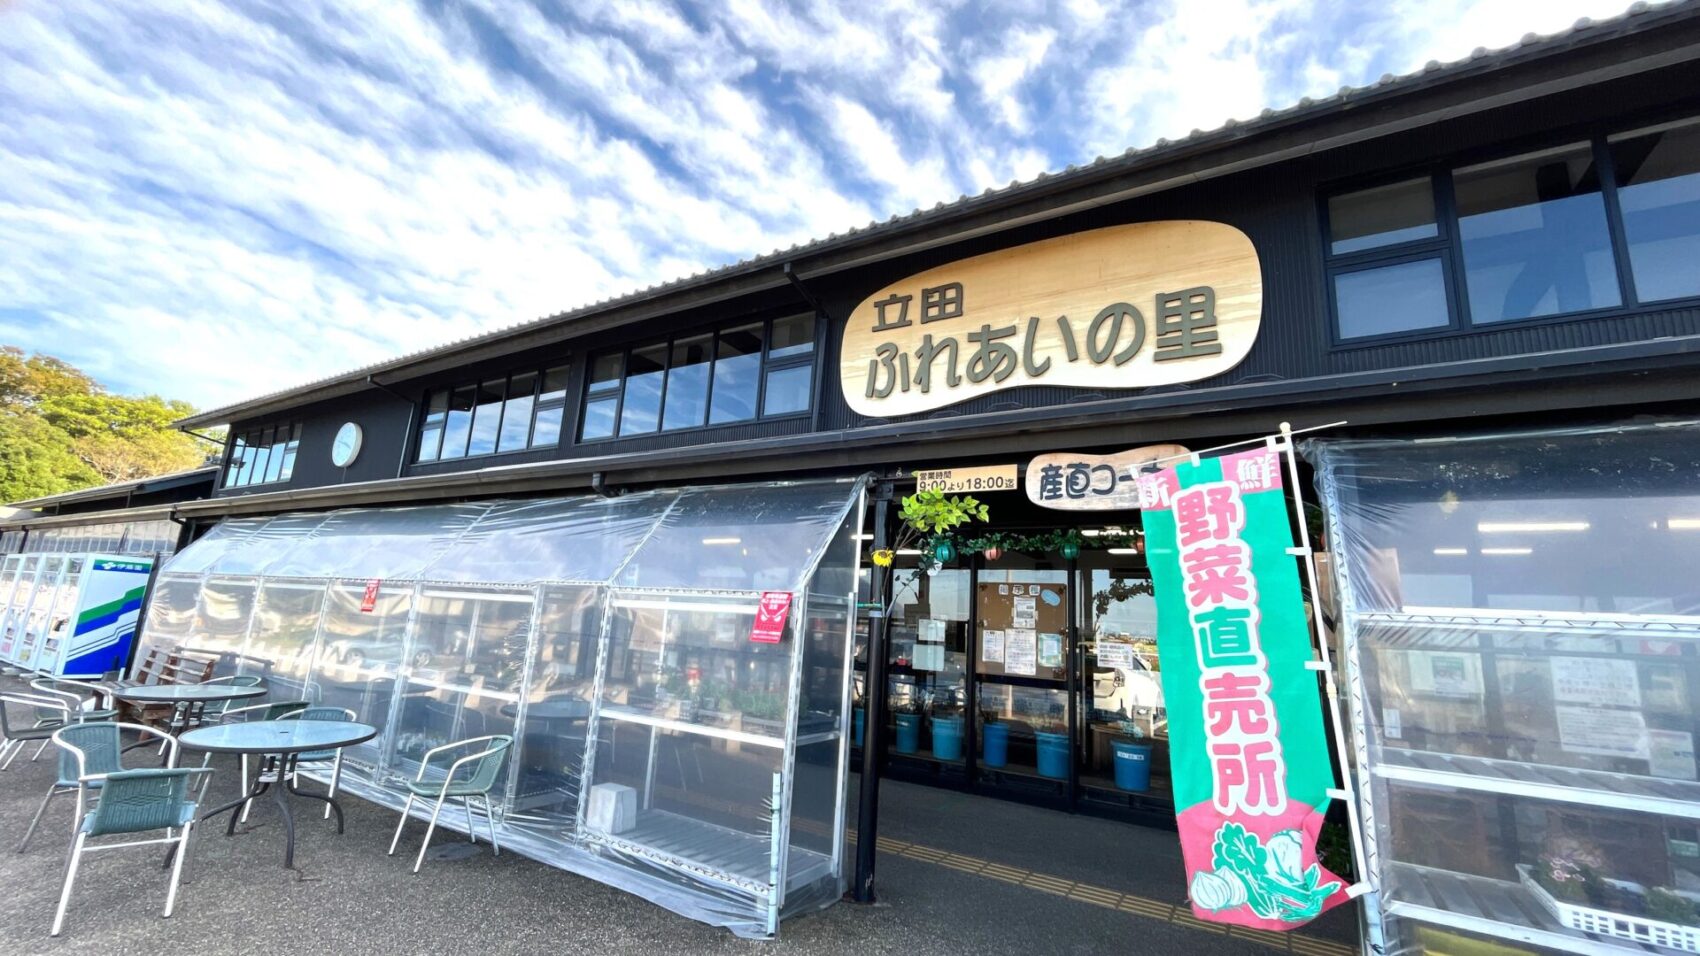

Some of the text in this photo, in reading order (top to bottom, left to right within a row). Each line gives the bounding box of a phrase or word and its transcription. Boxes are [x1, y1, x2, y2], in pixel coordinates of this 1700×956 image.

[865, 286, 1222, 398] ふれあいの里
[872, 282, 964, 332] 立田
[919, 471, 952, 480] 営業時間
[1174, 482, 1284, 815] 野菜直売所
